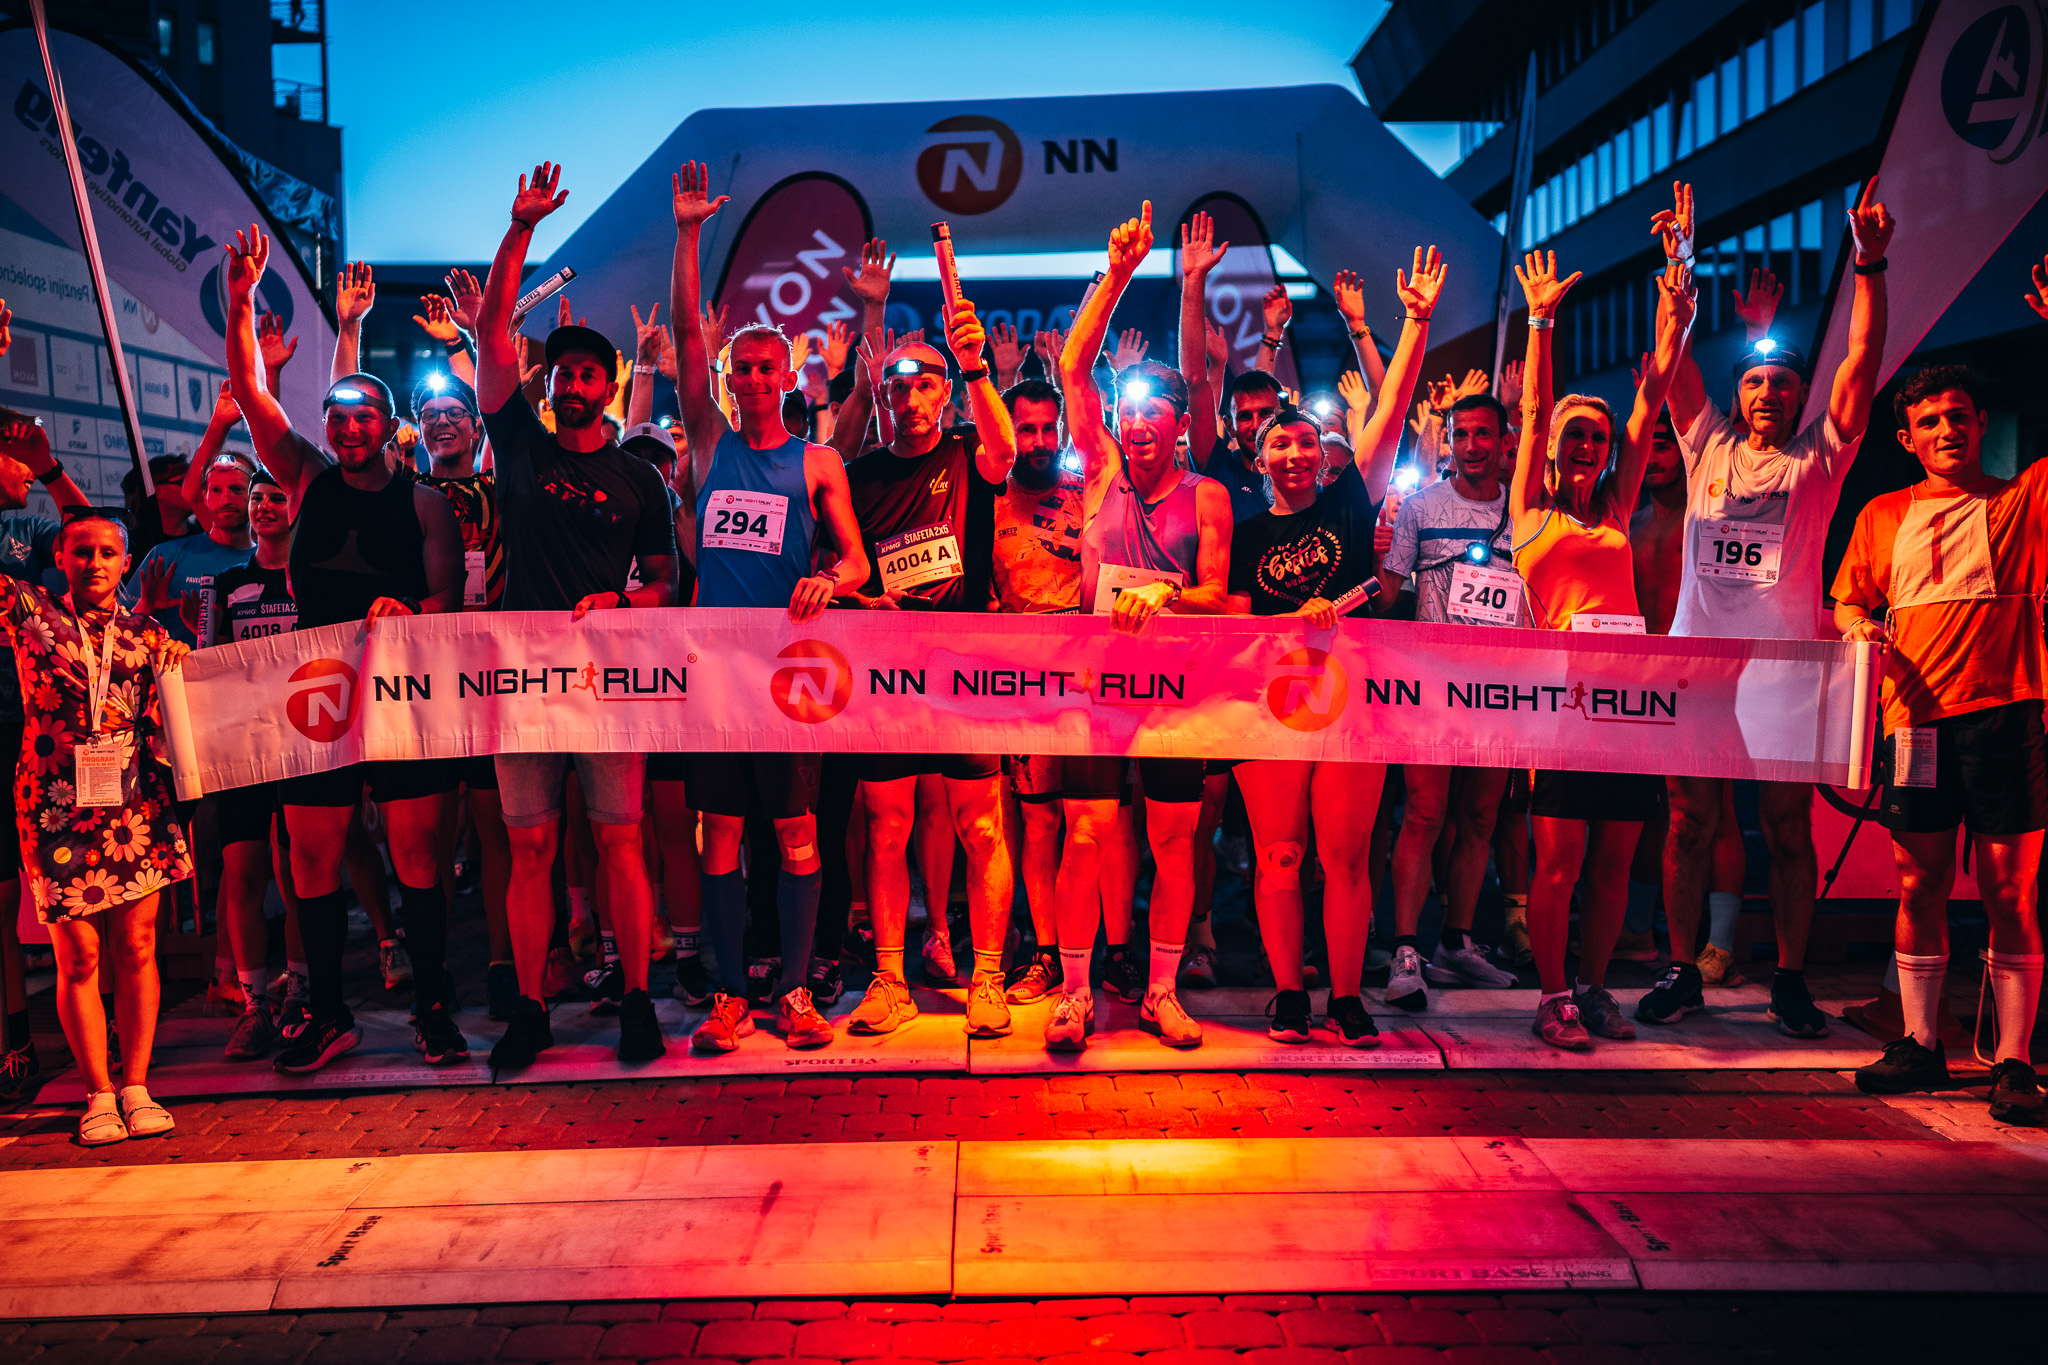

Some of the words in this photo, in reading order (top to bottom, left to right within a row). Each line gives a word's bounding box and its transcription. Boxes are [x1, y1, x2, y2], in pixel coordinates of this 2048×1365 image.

[1043, 138, 1119, 174] NN
[713, 509, 769, 538] 294
[998, 526, 1018, 537] SWEEP
[881, 541, 901, 553] KPMG
[903, 527, 935, 545] ŠTAFETA
[1712, 540, 1763, 567] 196
[1927, 511, 1946, 585] 1
[886, 548, 933, 575] 4004
[937, 545, 952, 561] A
[260, 602, 291, 614] ŠTAFETA
[1459, 582, 1508, 610] 240
[240, 623, 282, 640] 4018
[373, 674, 431, 702] NN
[458, 667, 578, 698] NIGHT
[868, 668, 926, 695] NN
[953, 669, 1076, 697] NIGHT
[1100, 672, 1185, 700] RUN
[1364, 678, 1421, 706] NN
[1447, 682, 1567, 712] NIGHT
[1372, 1267, 1465, 1280] SPORT
[1470, 1266, 1550, 1279] BASE
[1554, 1270, 1612, 1278] TIMING
